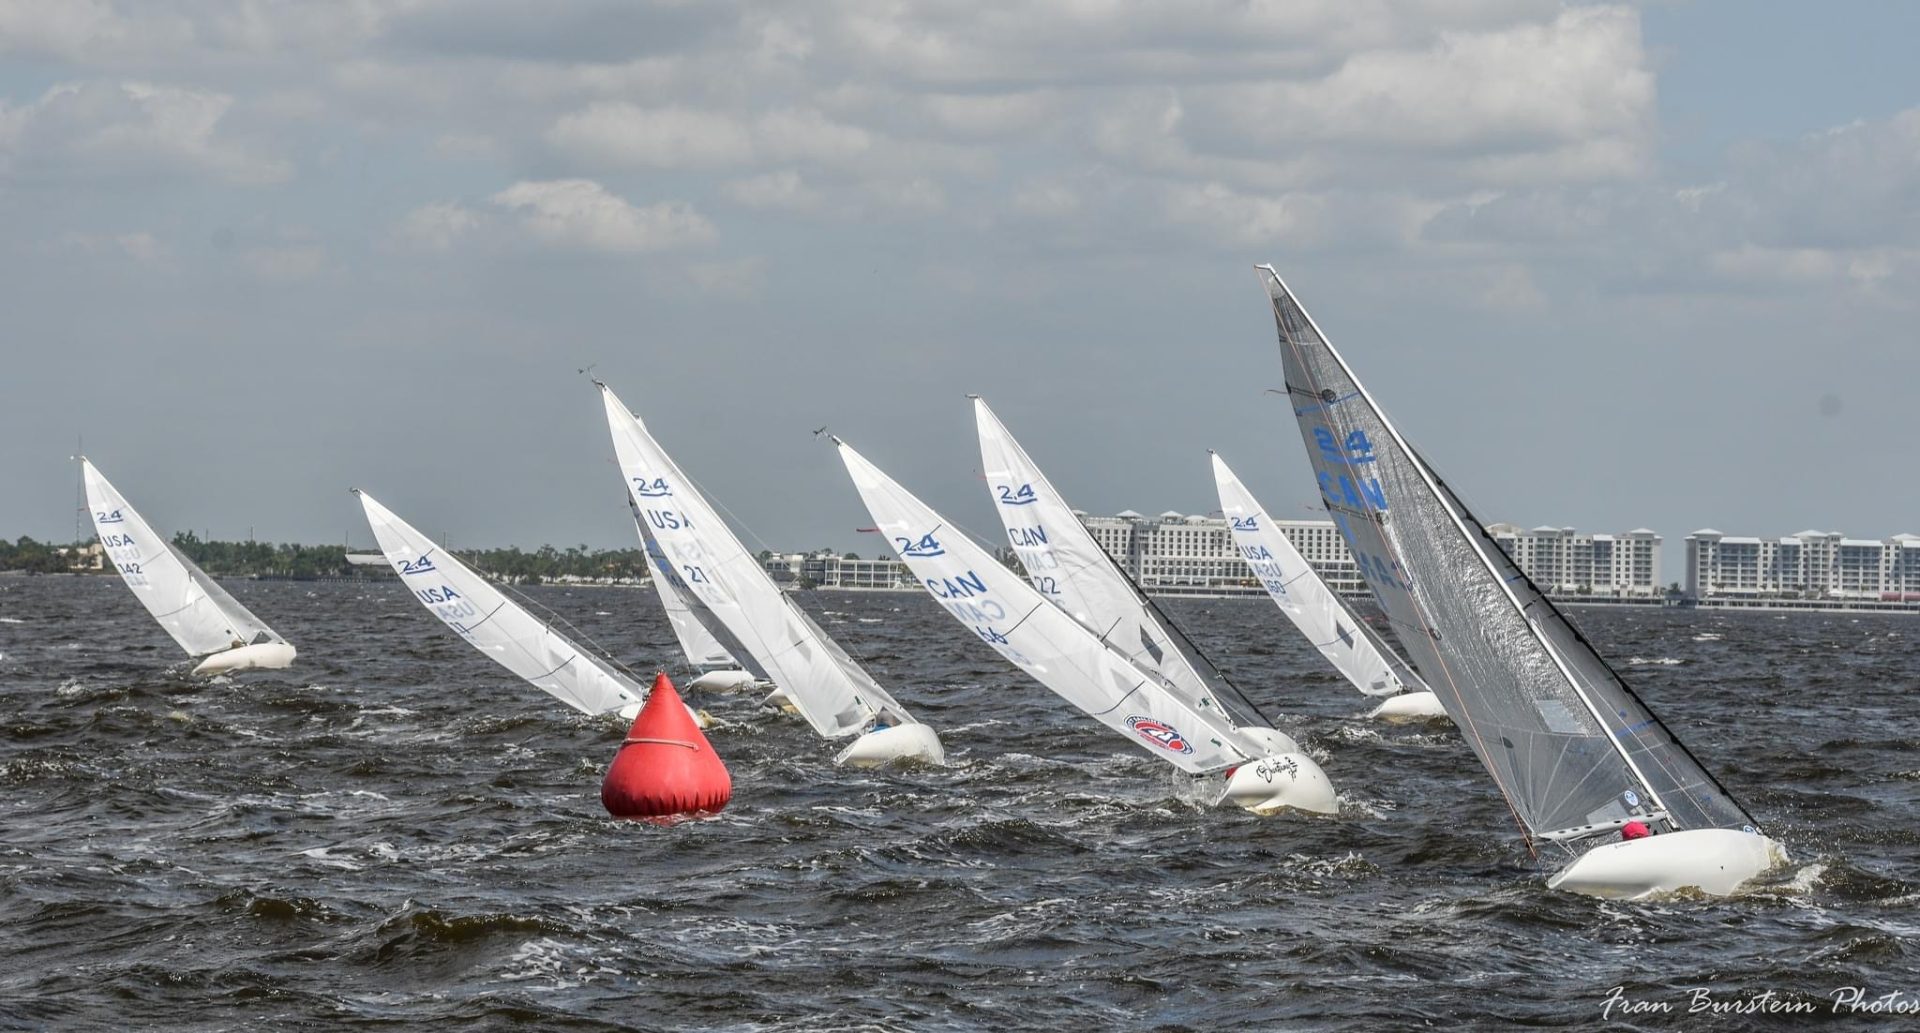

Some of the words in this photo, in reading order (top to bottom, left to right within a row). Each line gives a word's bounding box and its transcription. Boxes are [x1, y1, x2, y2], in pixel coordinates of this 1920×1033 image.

[1313, 426, 1373, 453] 2.4
[633, 477, 669, 492] 2.4
[997, 484, 1035, 500] 2.4
[1319, 471, 1388, 509] CAN
[97, 510, 122, 523] 2.4
[1231, 516, 1258, 528] 2.4
[102, 533, 135, 547] USA
[896, 534, 940, 551] 2.4
[1009, 525, 1048, 547] CAN
[1241, 545, 1273, 560] USA
[117, 563, 143, 574] 142
[398, 555, 432, 572] 2.4
[926, 570, 988, 600] CAN
[1034, 576, 1061, 595] 22
[417, 585, 460, 603] USA
